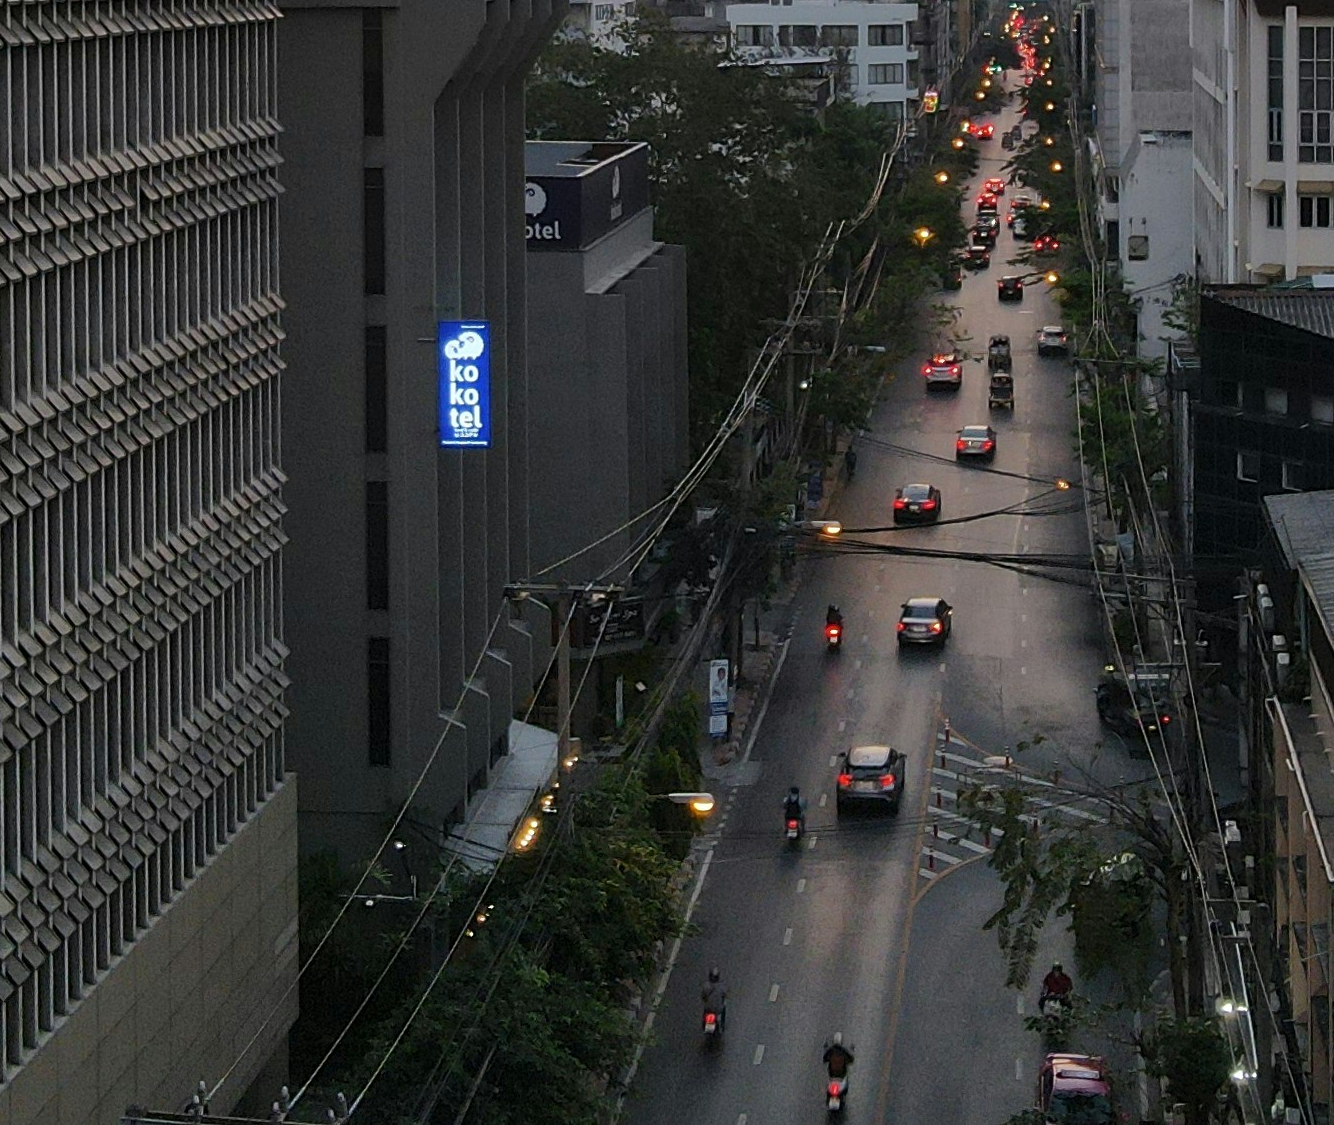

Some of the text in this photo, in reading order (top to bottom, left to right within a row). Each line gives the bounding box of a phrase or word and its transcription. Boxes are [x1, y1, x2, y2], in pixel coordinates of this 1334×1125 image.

[449, 359, 479, 382] ko
[449, 382, 479, 405] ko
[449, 405, 483, 428] tel
